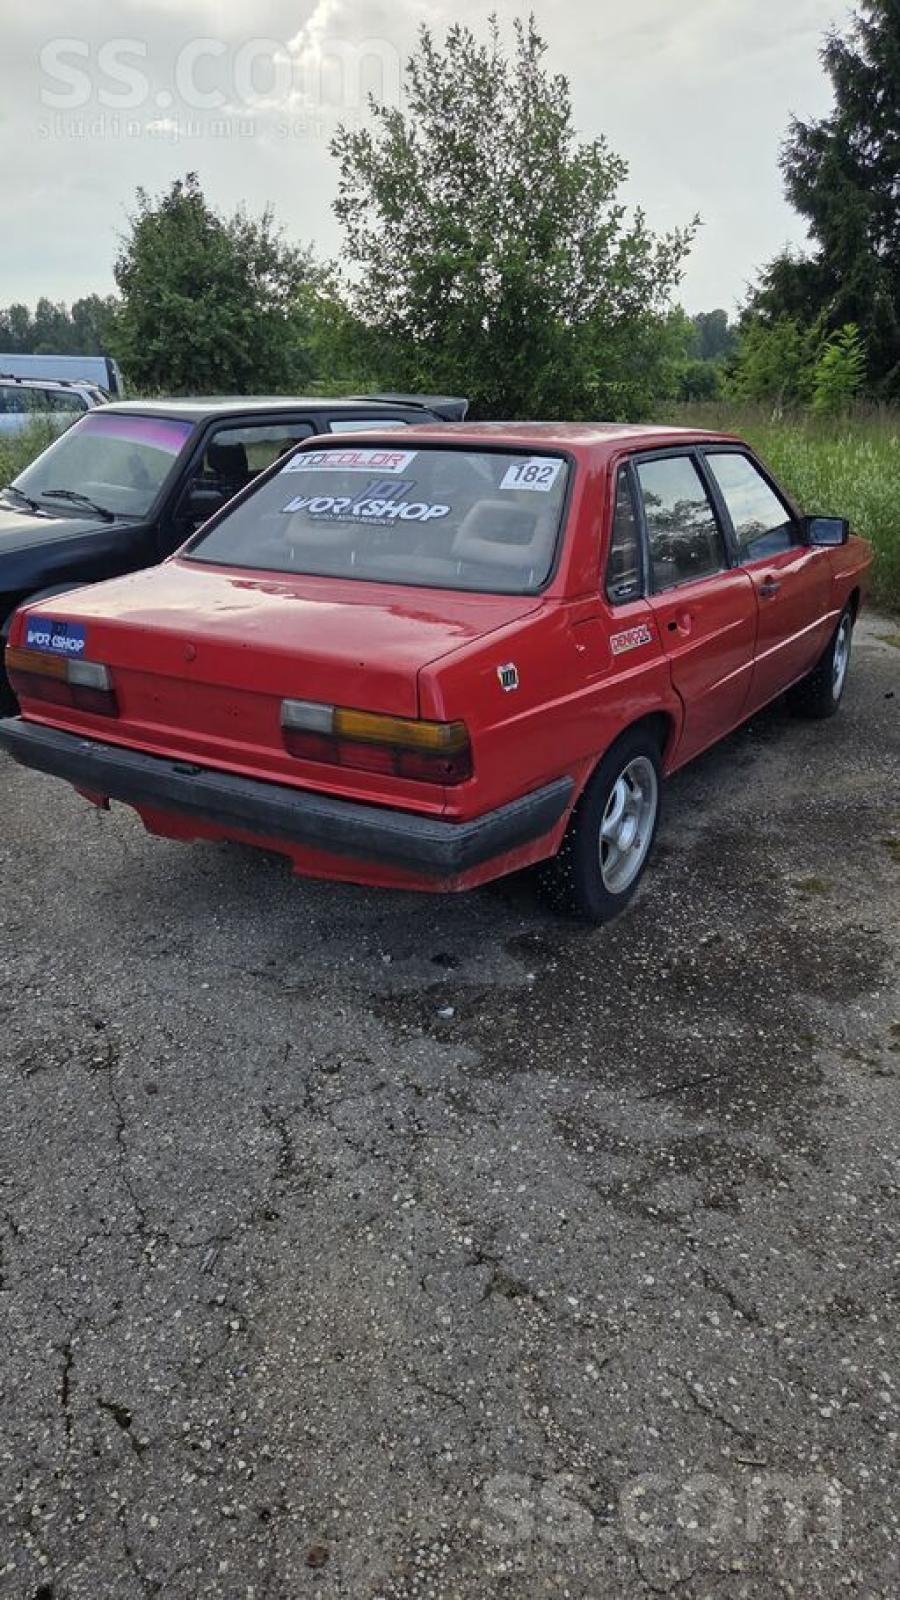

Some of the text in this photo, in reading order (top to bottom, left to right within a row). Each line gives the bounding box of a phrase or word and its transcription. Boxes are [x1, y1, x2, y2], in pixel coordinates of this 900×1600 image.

[513, 465, 553, 483] 182
[281, 496, 451, 522] WORKSHOP
[27, 630, 85, 652] WORKSHOP
